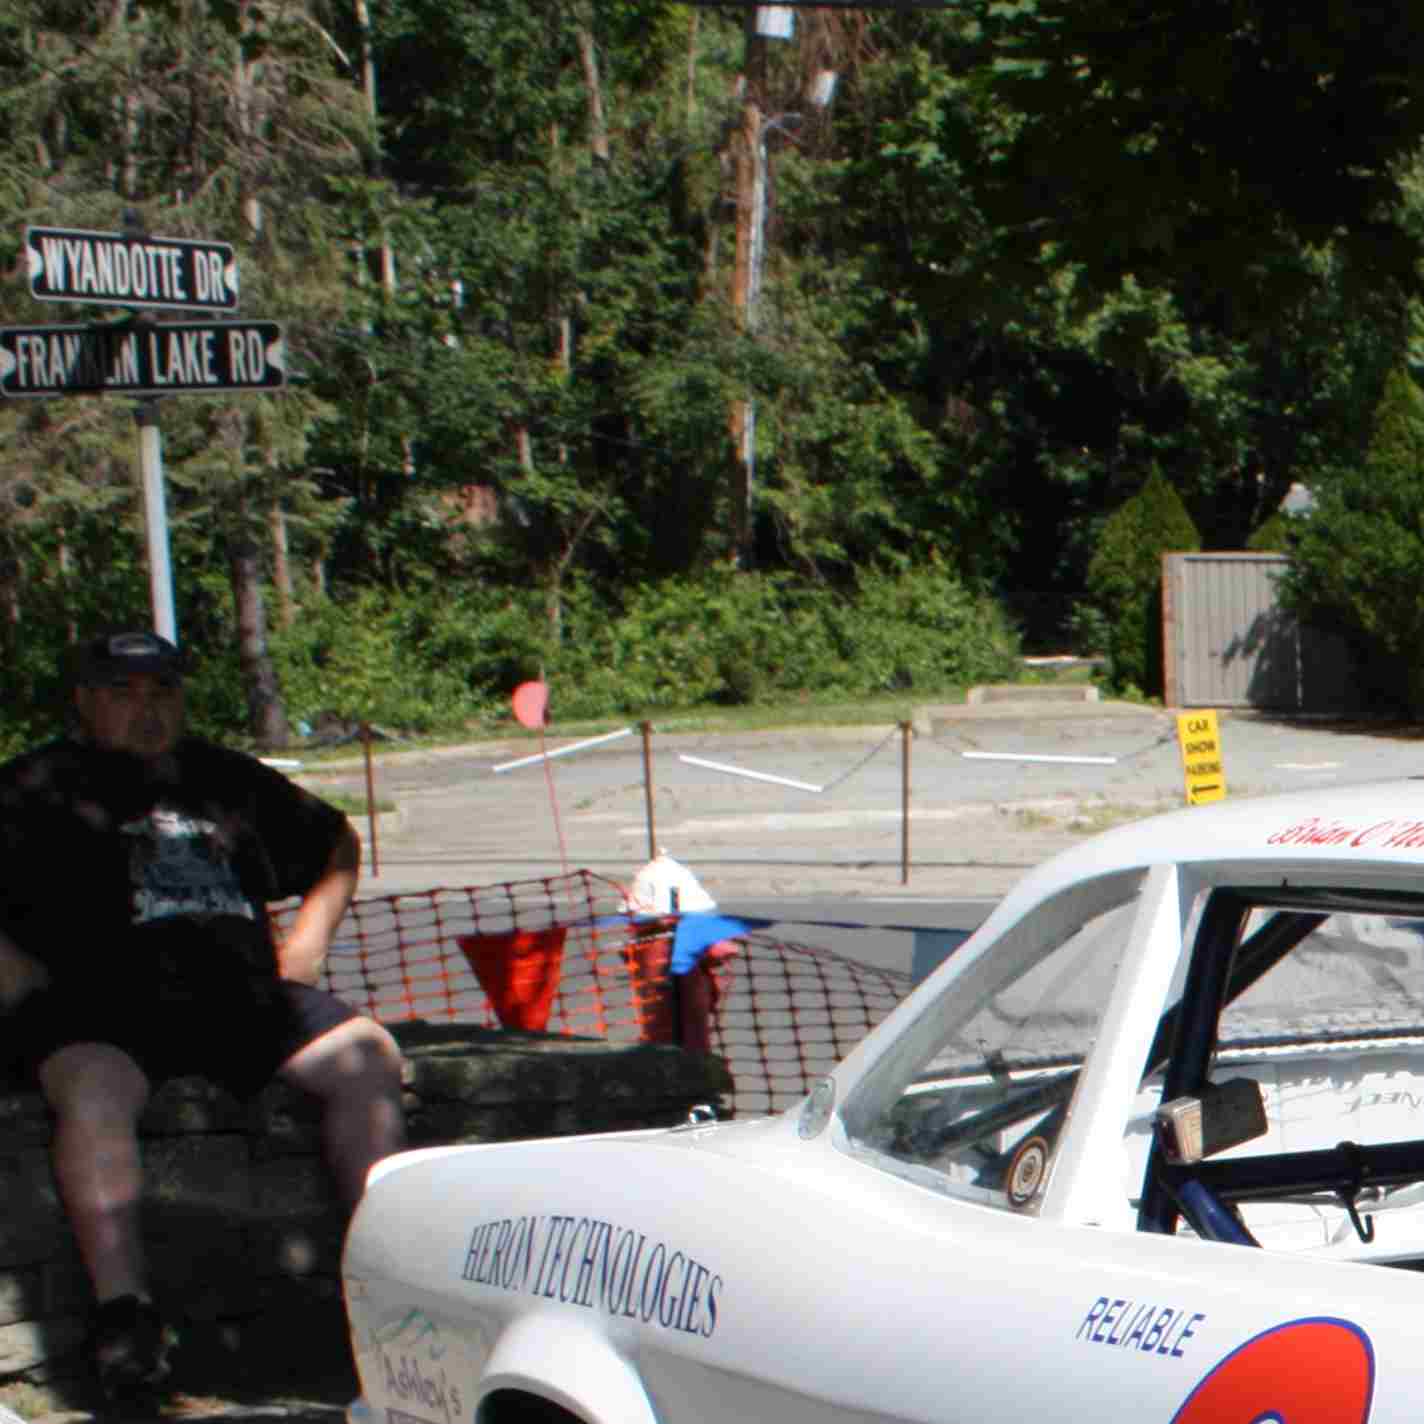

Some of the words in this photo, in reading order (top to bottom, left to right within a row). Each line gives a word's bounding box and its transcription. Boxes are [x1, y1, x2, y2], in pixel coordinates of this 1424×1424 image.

[42, 237, 187, 299] WYANDOTTE
[193, 248, 227, 301] DR
[150, 331, 218, 384] LAKE
[227, 329, 266, 384] RD
[461, 1216, 543, 1292] HERON
[533, 1216, 723, 1338] TECHNOLOGIES
[1076, 1297, 1206, 1358] RELIABLE
[384, 1355, 462, 1424] Ashley's
